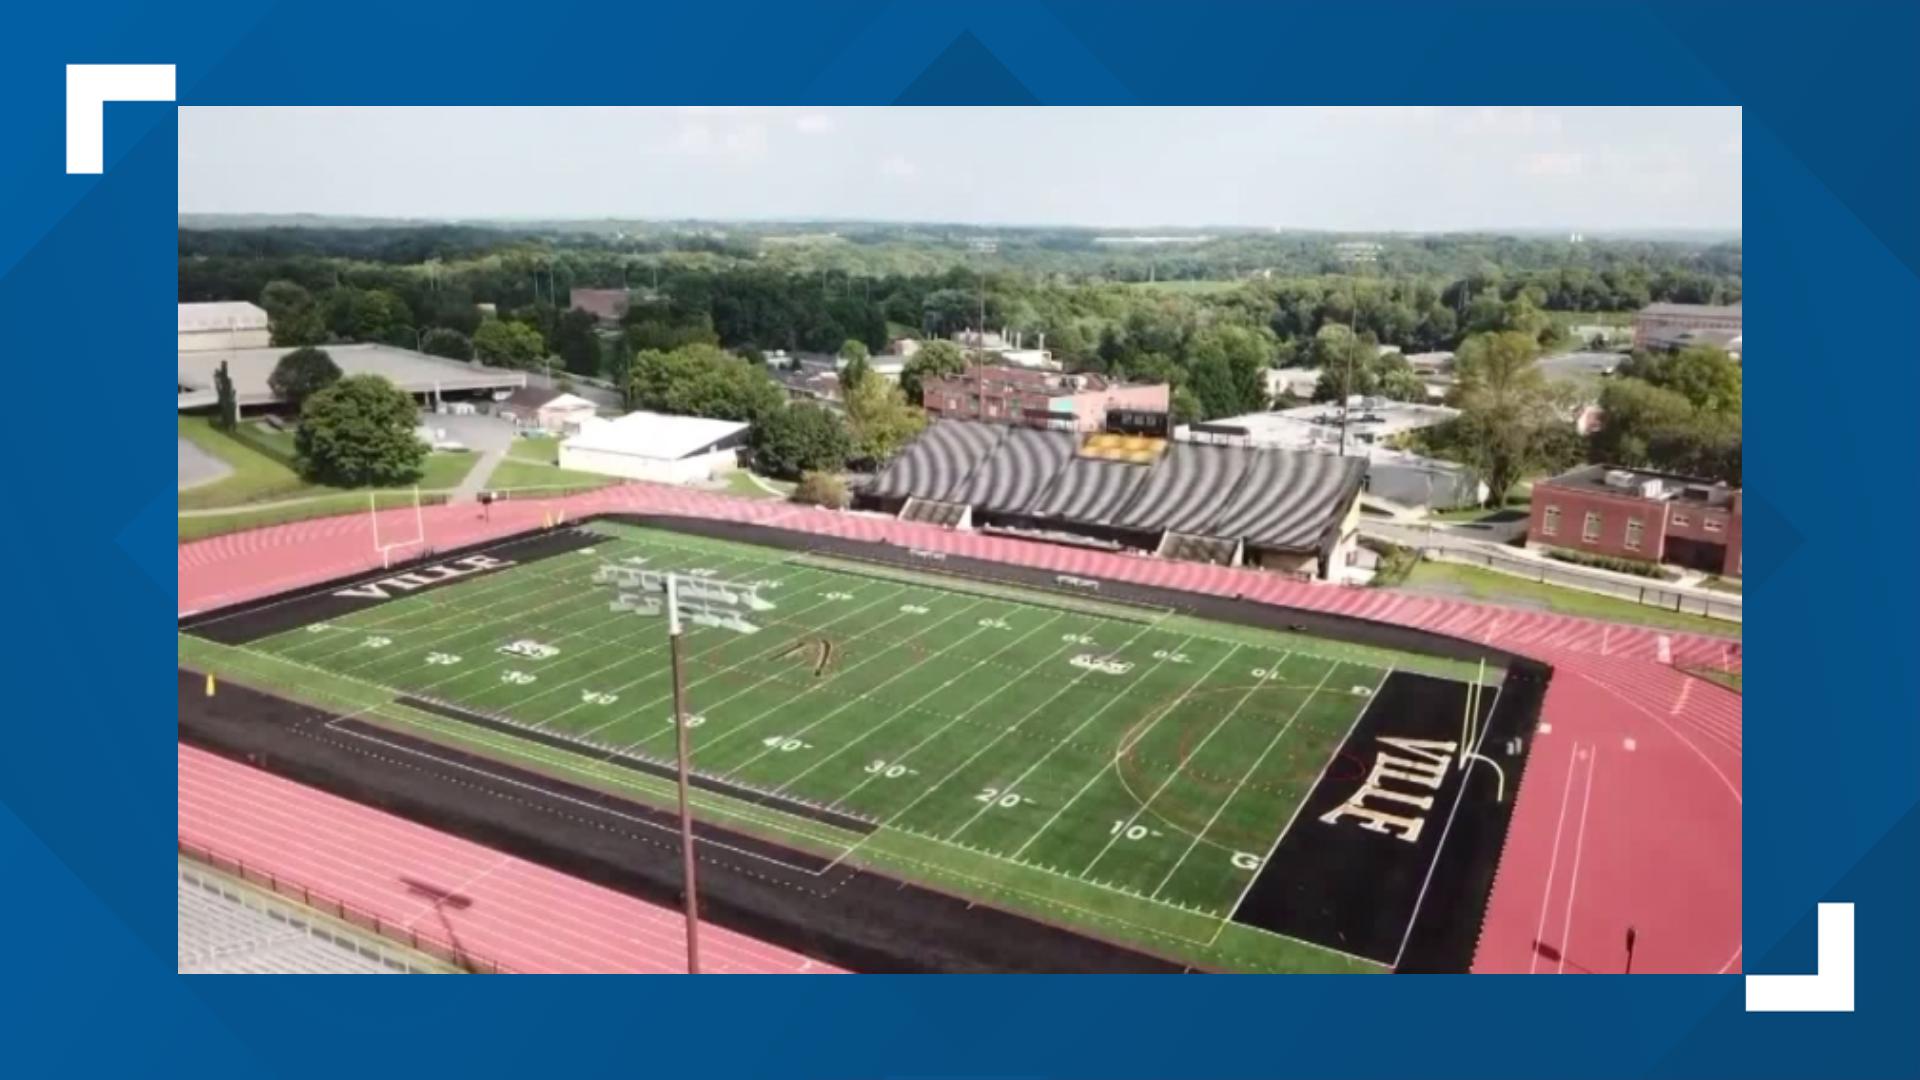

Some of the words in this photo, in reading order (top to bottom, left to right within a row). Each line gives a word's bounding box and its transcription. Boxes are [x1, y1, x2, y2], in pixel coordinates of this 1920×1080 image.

[863, 759, 907, 778] 30
[973, 788, 1021, 808] 20
[1318, 736, 1457, 843] VILLE
[1110, 820, 1148, 840] 10
[1230, 851, 1262, 870] G
